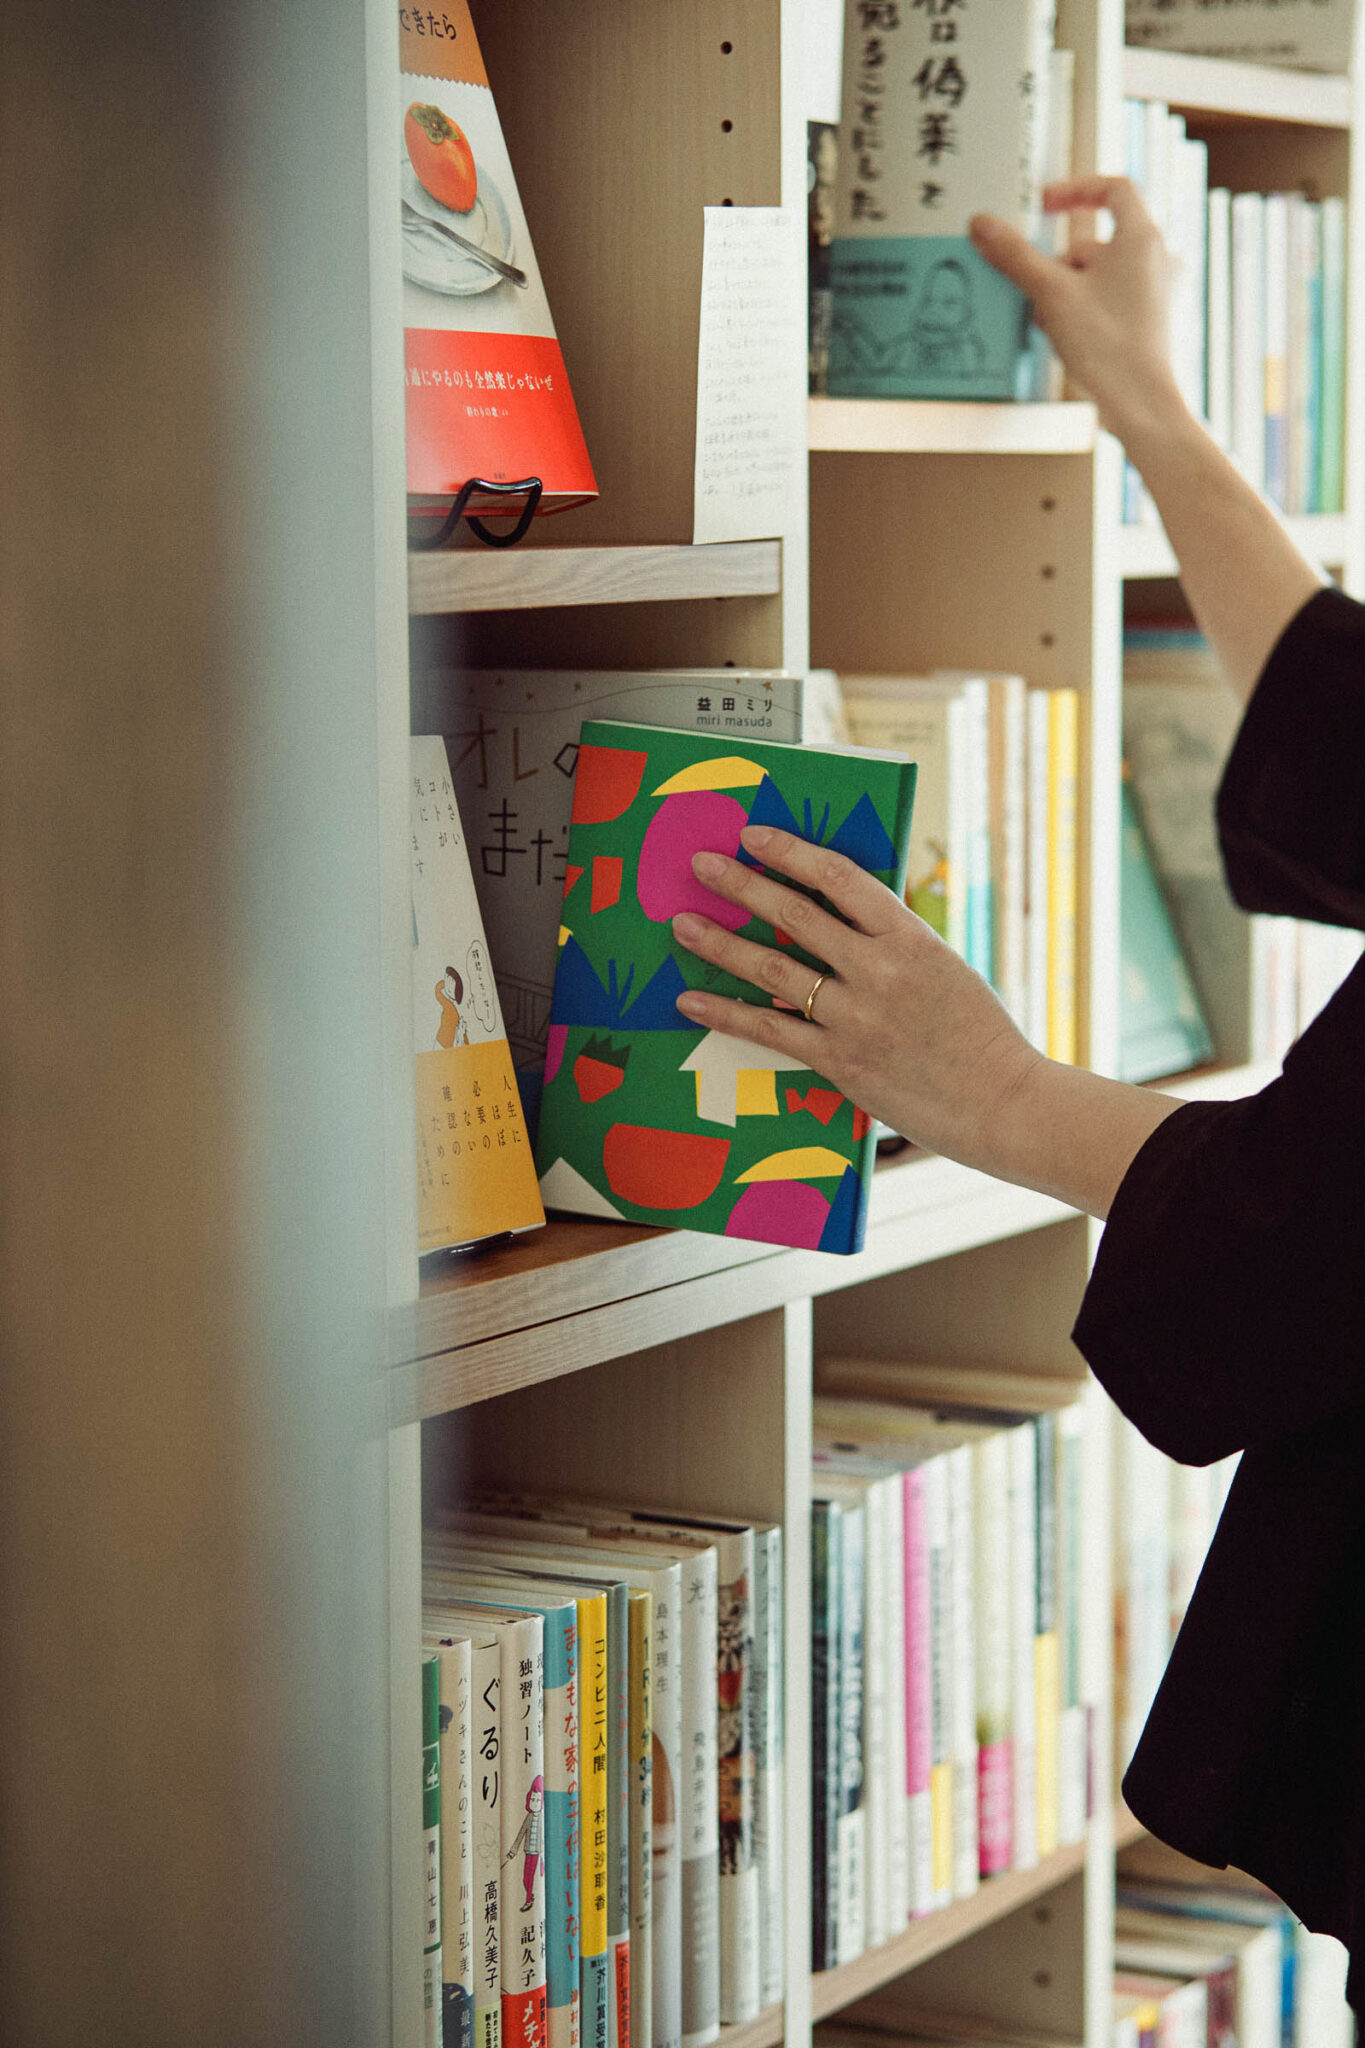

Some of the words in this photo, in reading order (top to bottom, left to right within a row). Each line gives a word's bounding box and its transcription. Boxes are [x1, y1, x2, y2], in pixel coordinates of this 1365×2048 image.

[402, 367, 554, 391] 通にやるのも全然楽じゃないぜ
[696, 715, 720, 726] miri
[725, 715, 773, 728] masuda
[697, 697, 773, 713] 益田ミリ
[429, 781, 448, 848] コトが
[442, 776, 461, 846] 小さい
[463, 1109, 477, 1152] ない
[472, 1080, 492, 1151] 必要の
[503, 1074, 522, 1144] 人生に
[656, 1602, 668, 1694] 島本理生
[519, 1657, 533, 1765] 独習ノート
[593, 1637, 606, 1775] コンビニ人間
[479, 1677, 501, 1809] ぐるり
[459, 1885, 470, 1977] 川上弘美
[484, 1879, 499, 1989] 高橋久美子
[520, 1924, 536, 1987] 記久子
